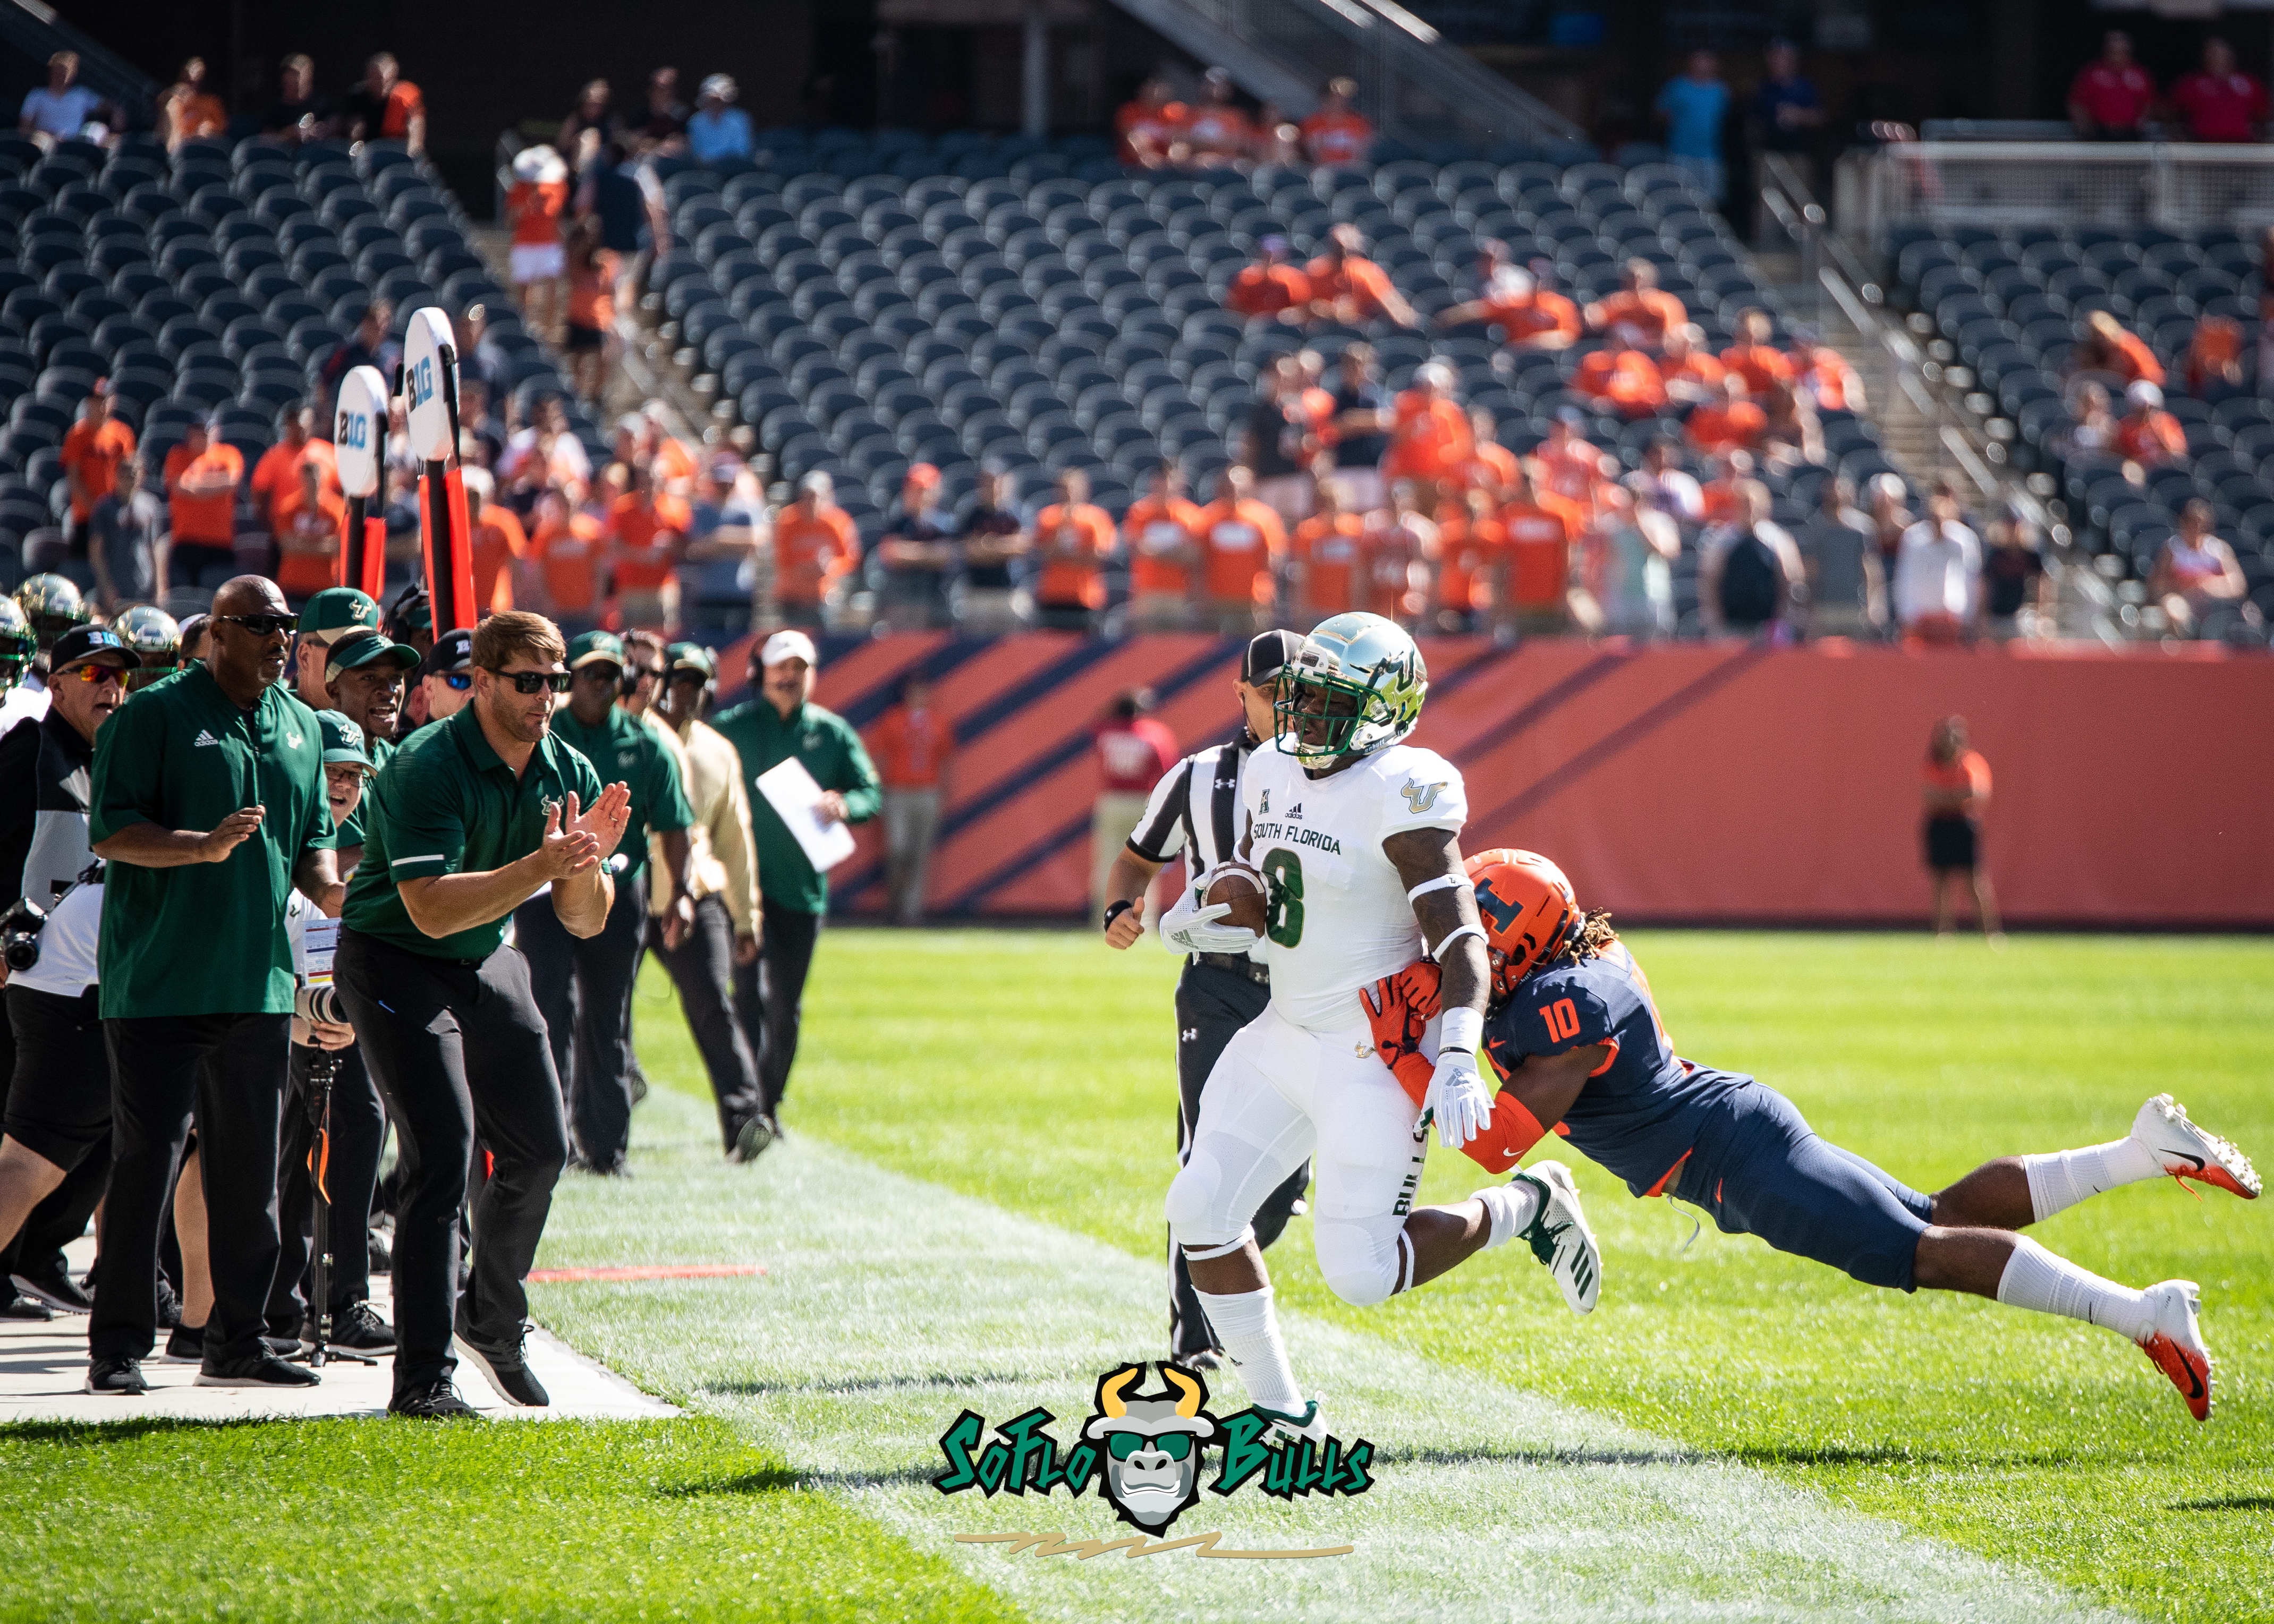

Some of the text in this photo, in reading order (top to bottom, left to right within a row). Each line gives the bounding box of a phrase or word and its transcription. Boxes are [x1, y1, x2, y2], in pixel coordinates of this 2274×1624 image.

[1364, 738, 1385, 753] schutt
[1253, 822, 1341, 855] SOUTH FLORIDA
[1261, 846, 1305, 949] 8
[1171, 934, 1199, 950] adidas
[1539, 998, 1581, 1043] 10
